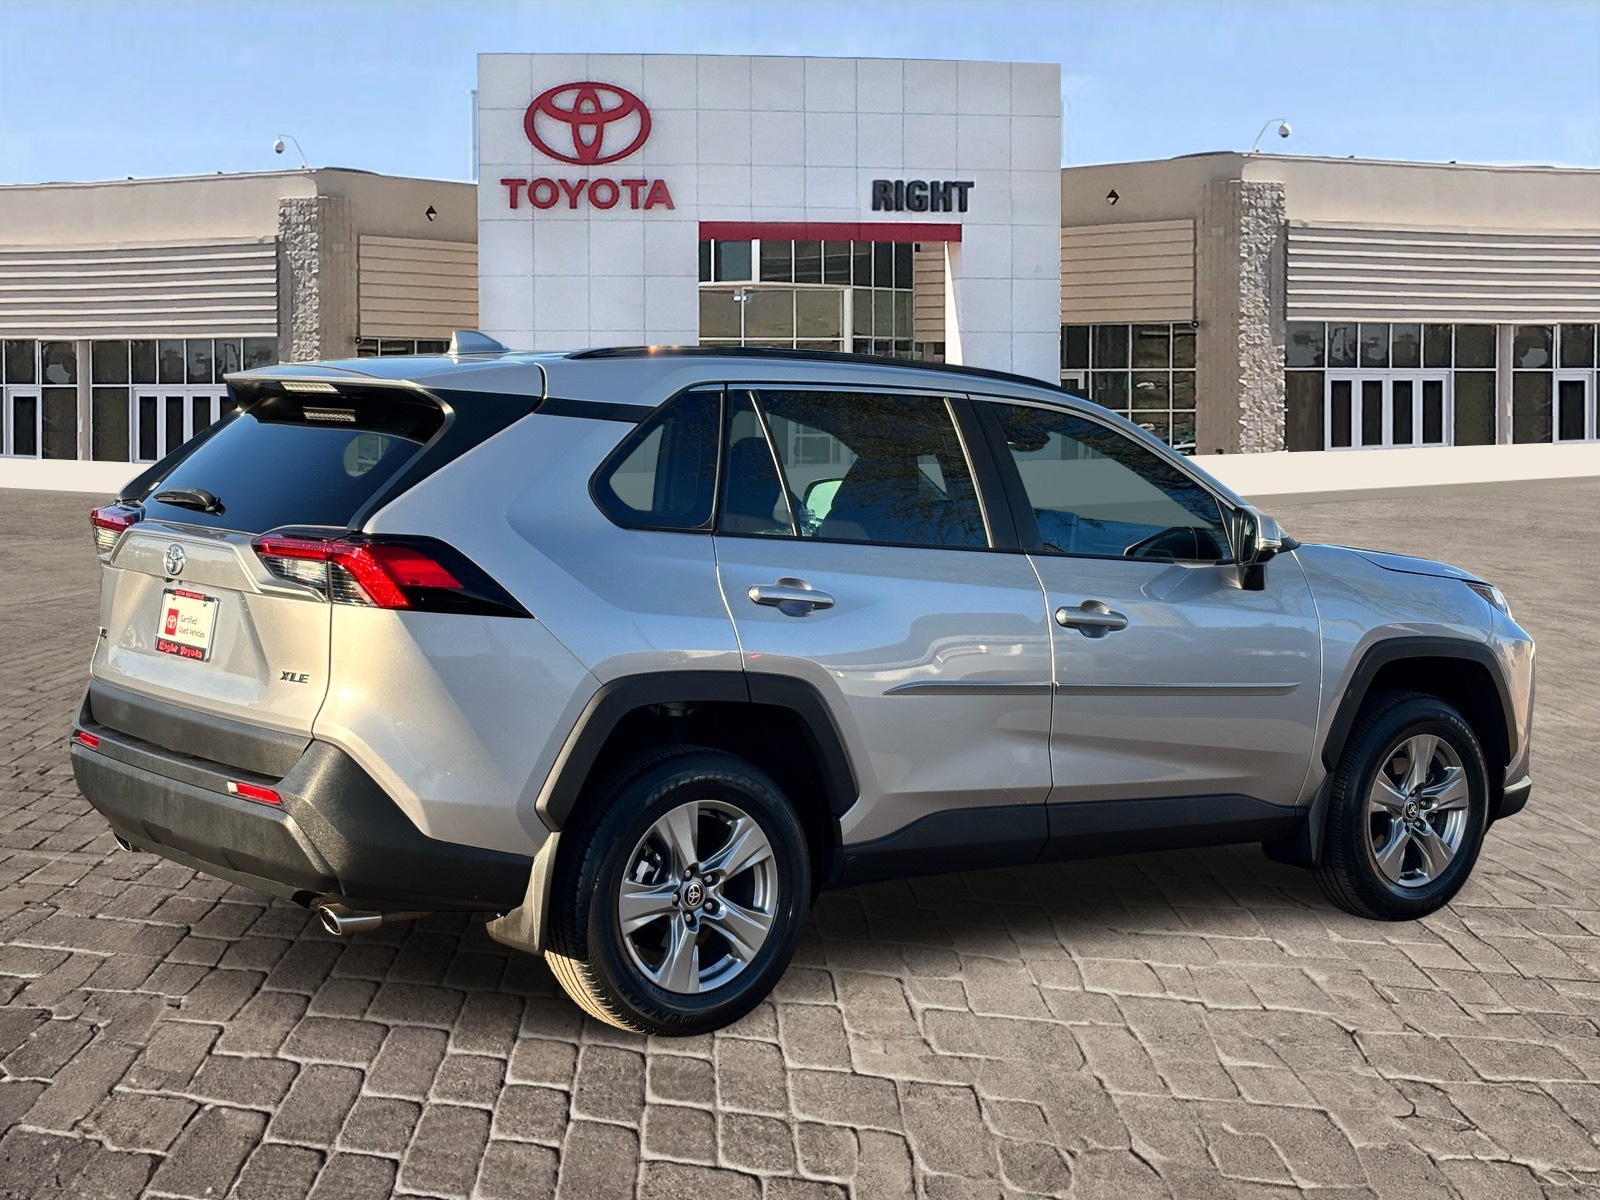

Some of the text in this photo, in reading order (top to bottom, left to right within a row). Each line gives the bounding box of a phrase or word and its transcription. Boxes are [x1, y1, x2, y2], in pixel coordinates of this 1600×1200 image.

[500, 178, 675, 210] TOYOTA
[872, 180, 974, 212] RIGHT
[280, 671, 310, 683] XLE
